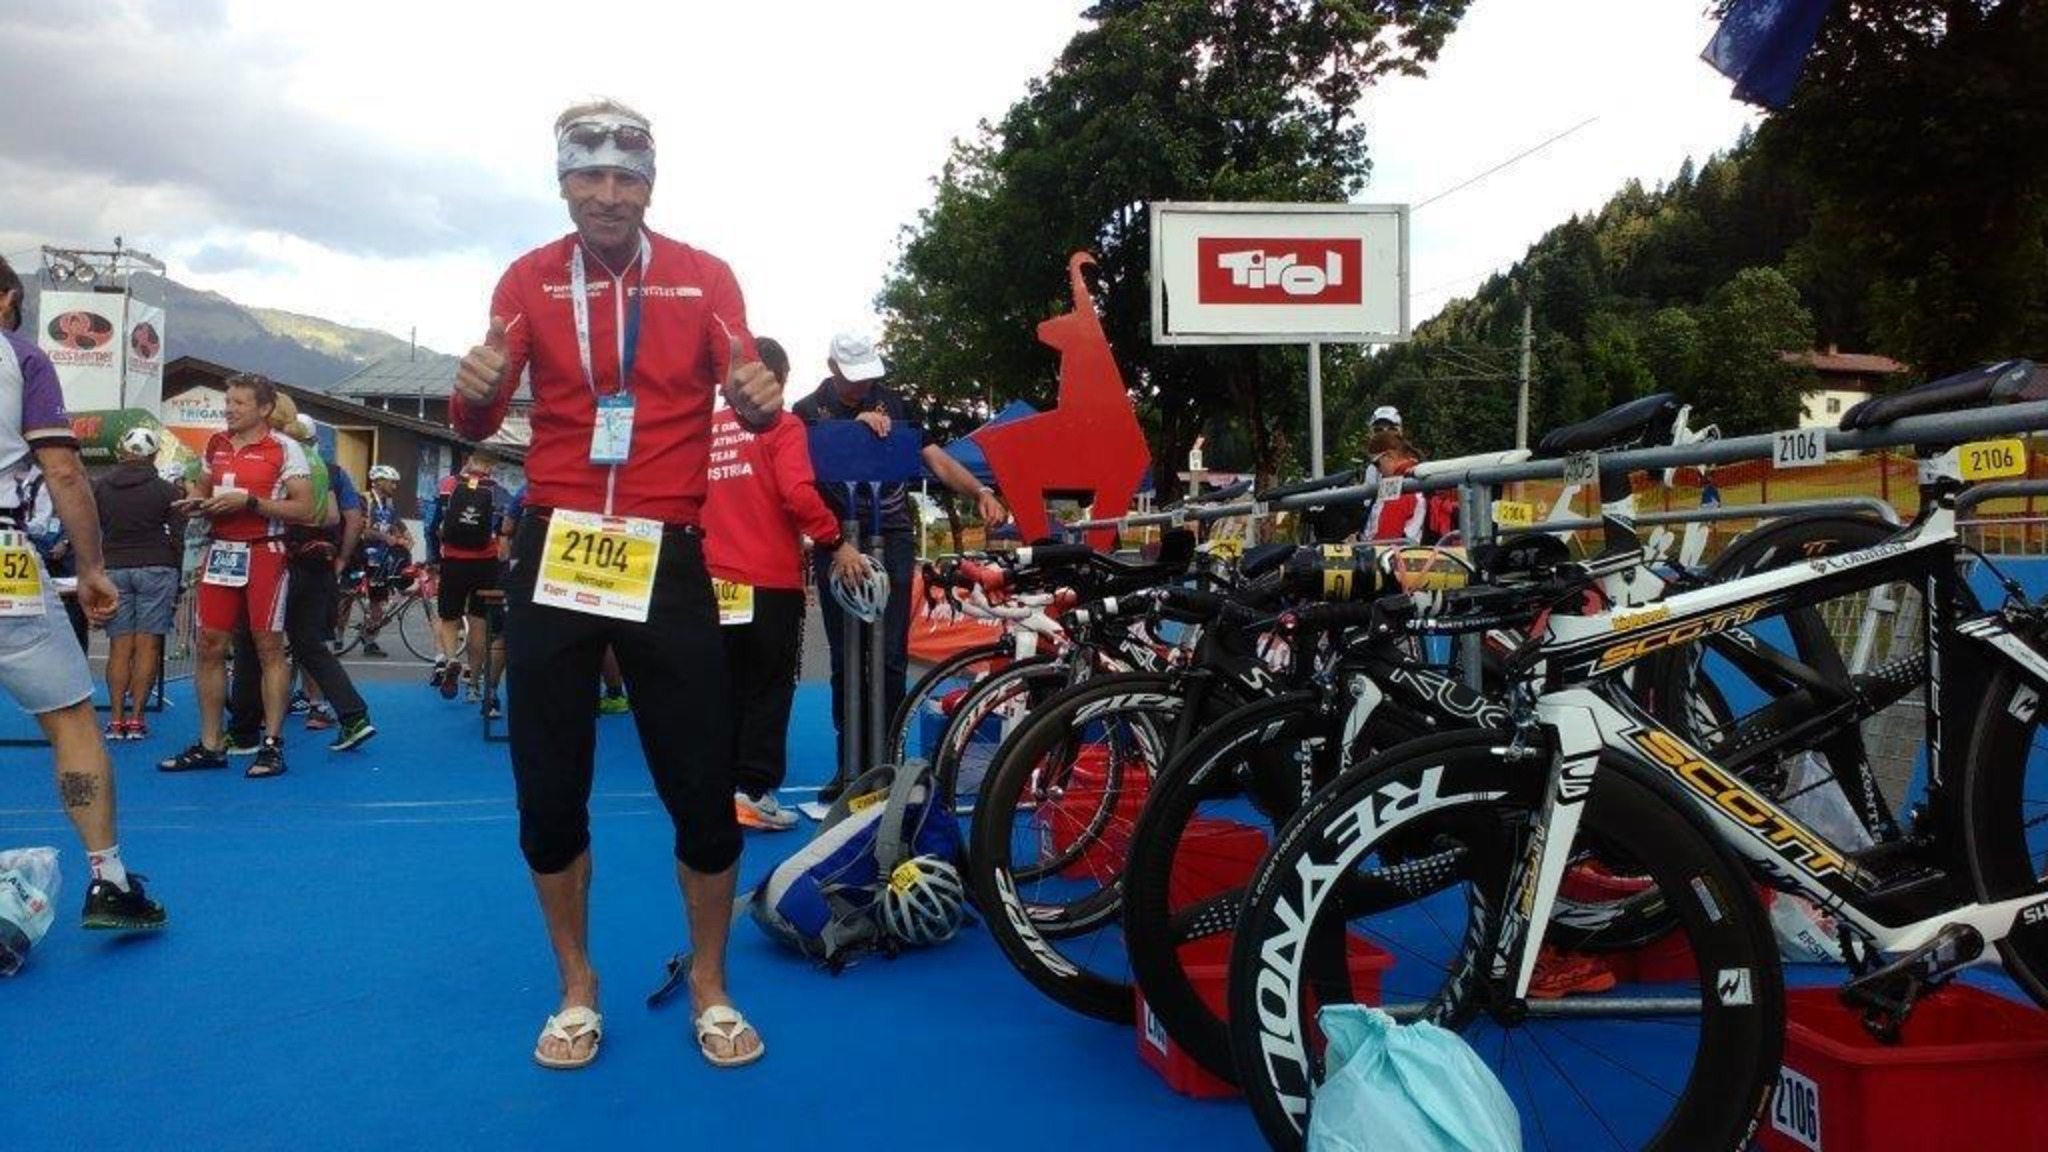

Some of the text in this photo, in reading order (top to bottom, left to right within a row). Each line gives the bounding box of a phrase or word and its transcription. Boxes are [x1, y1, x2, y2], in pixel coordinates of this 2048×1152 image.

[1218, 250, 1343, 295] Tirol
[1779, 432, 1818, 462] 2106
[1972, 448, 2014, 472] 2106
[3, 553, 29, 579] 52
[560, 529, 630, 574] 2104
[1598, 600, 1772, 669] SCOTT
[1636, 729, 1852, 880] SCOTT
[1775, 1072, 1818, 1143] 2106
